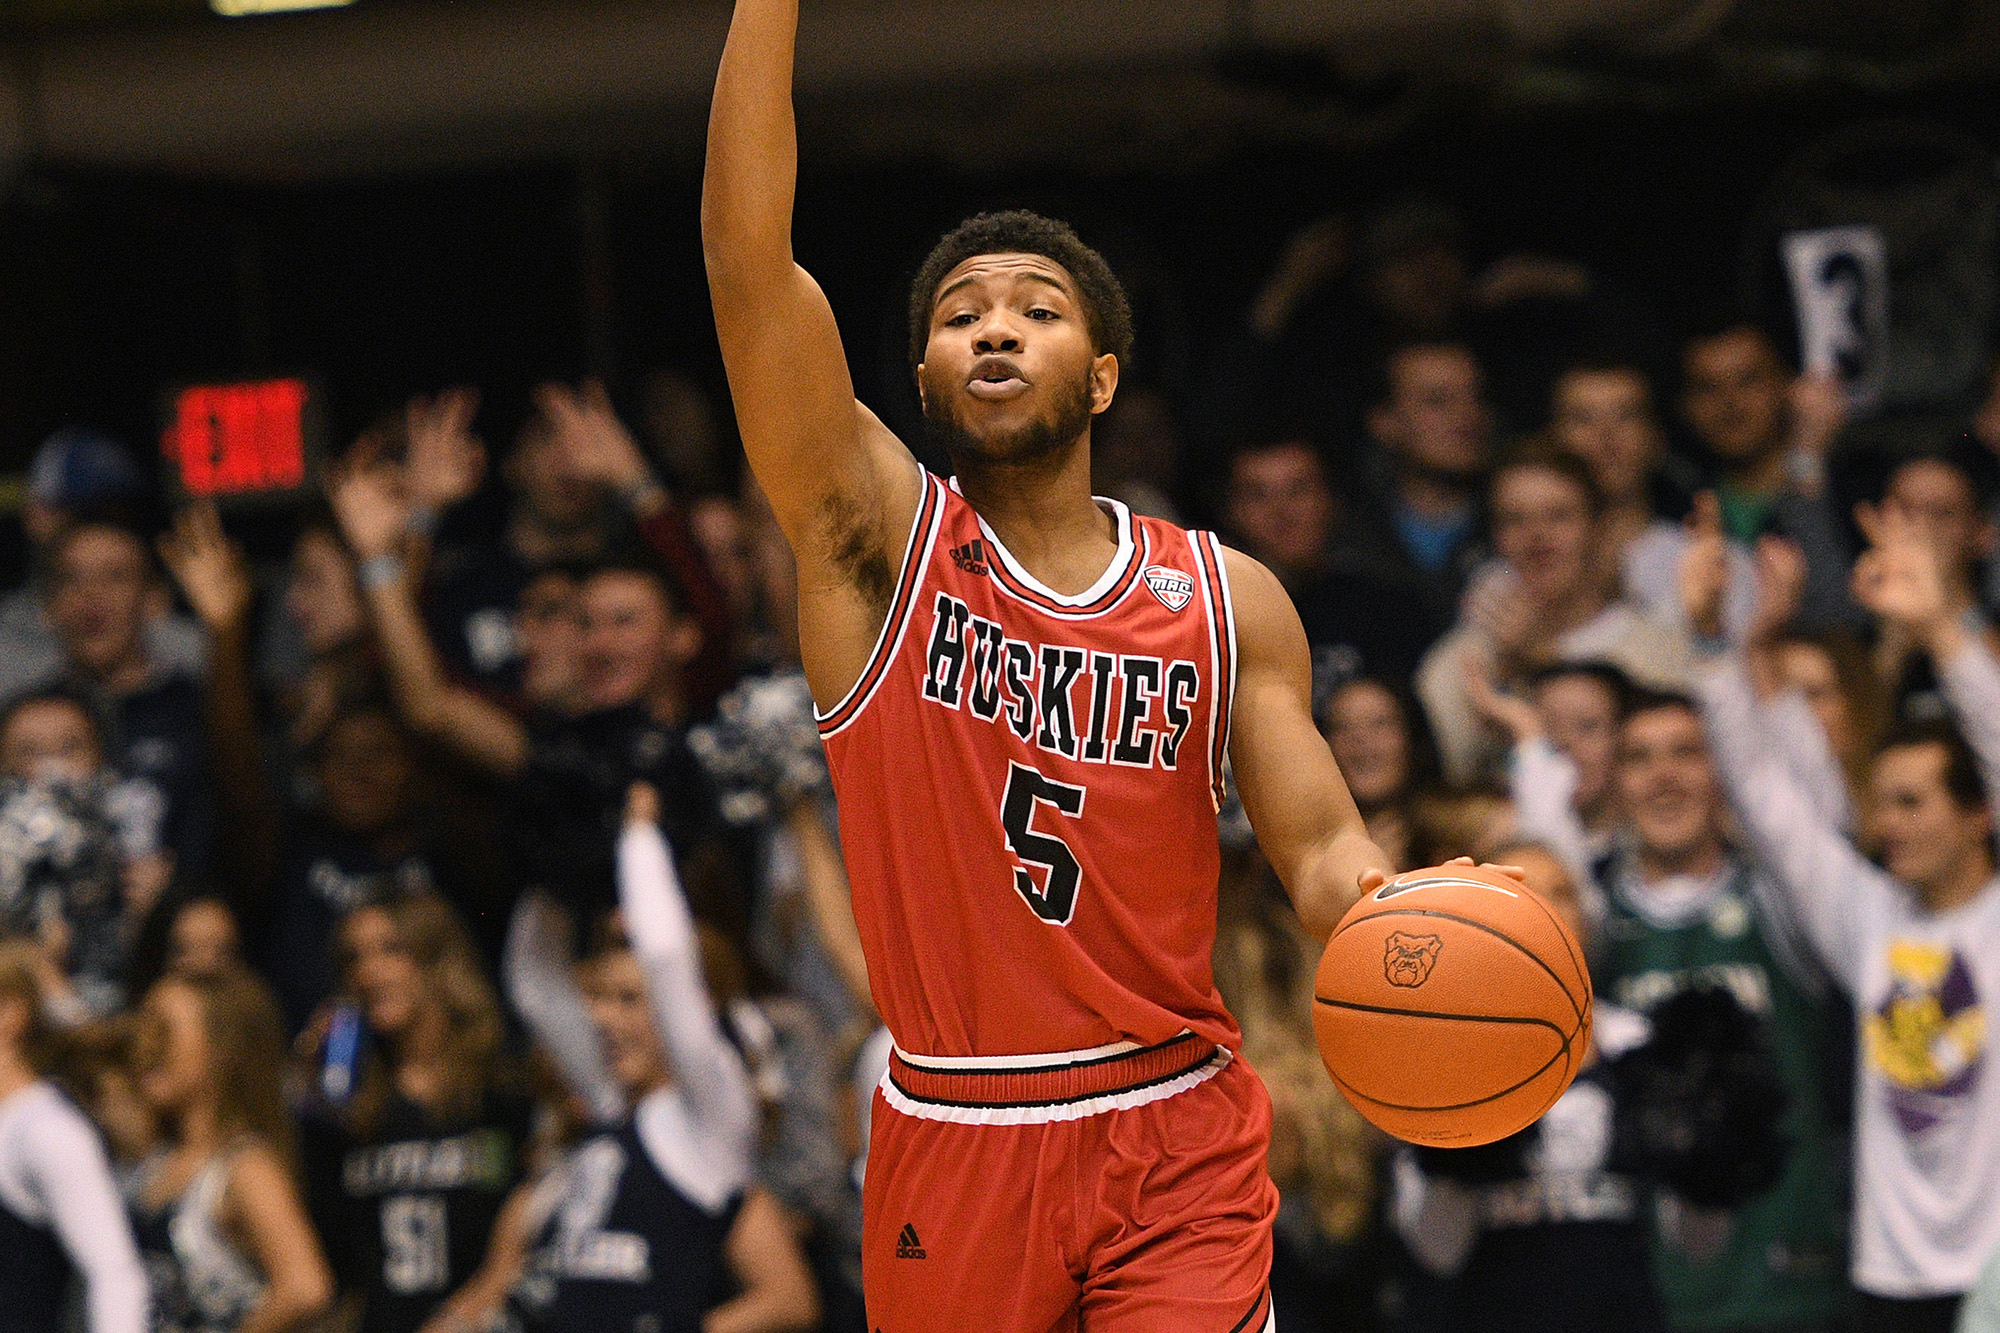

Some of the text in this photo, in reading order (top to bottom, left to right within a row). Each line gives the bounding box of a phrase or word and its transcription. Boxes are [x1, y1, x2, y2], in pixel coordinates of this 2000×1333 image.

[1150, 578, 1193, 596] MAC
[922, 591, 1199, 770] HUSKIES
[1000, 759, 1086, 927] 5
